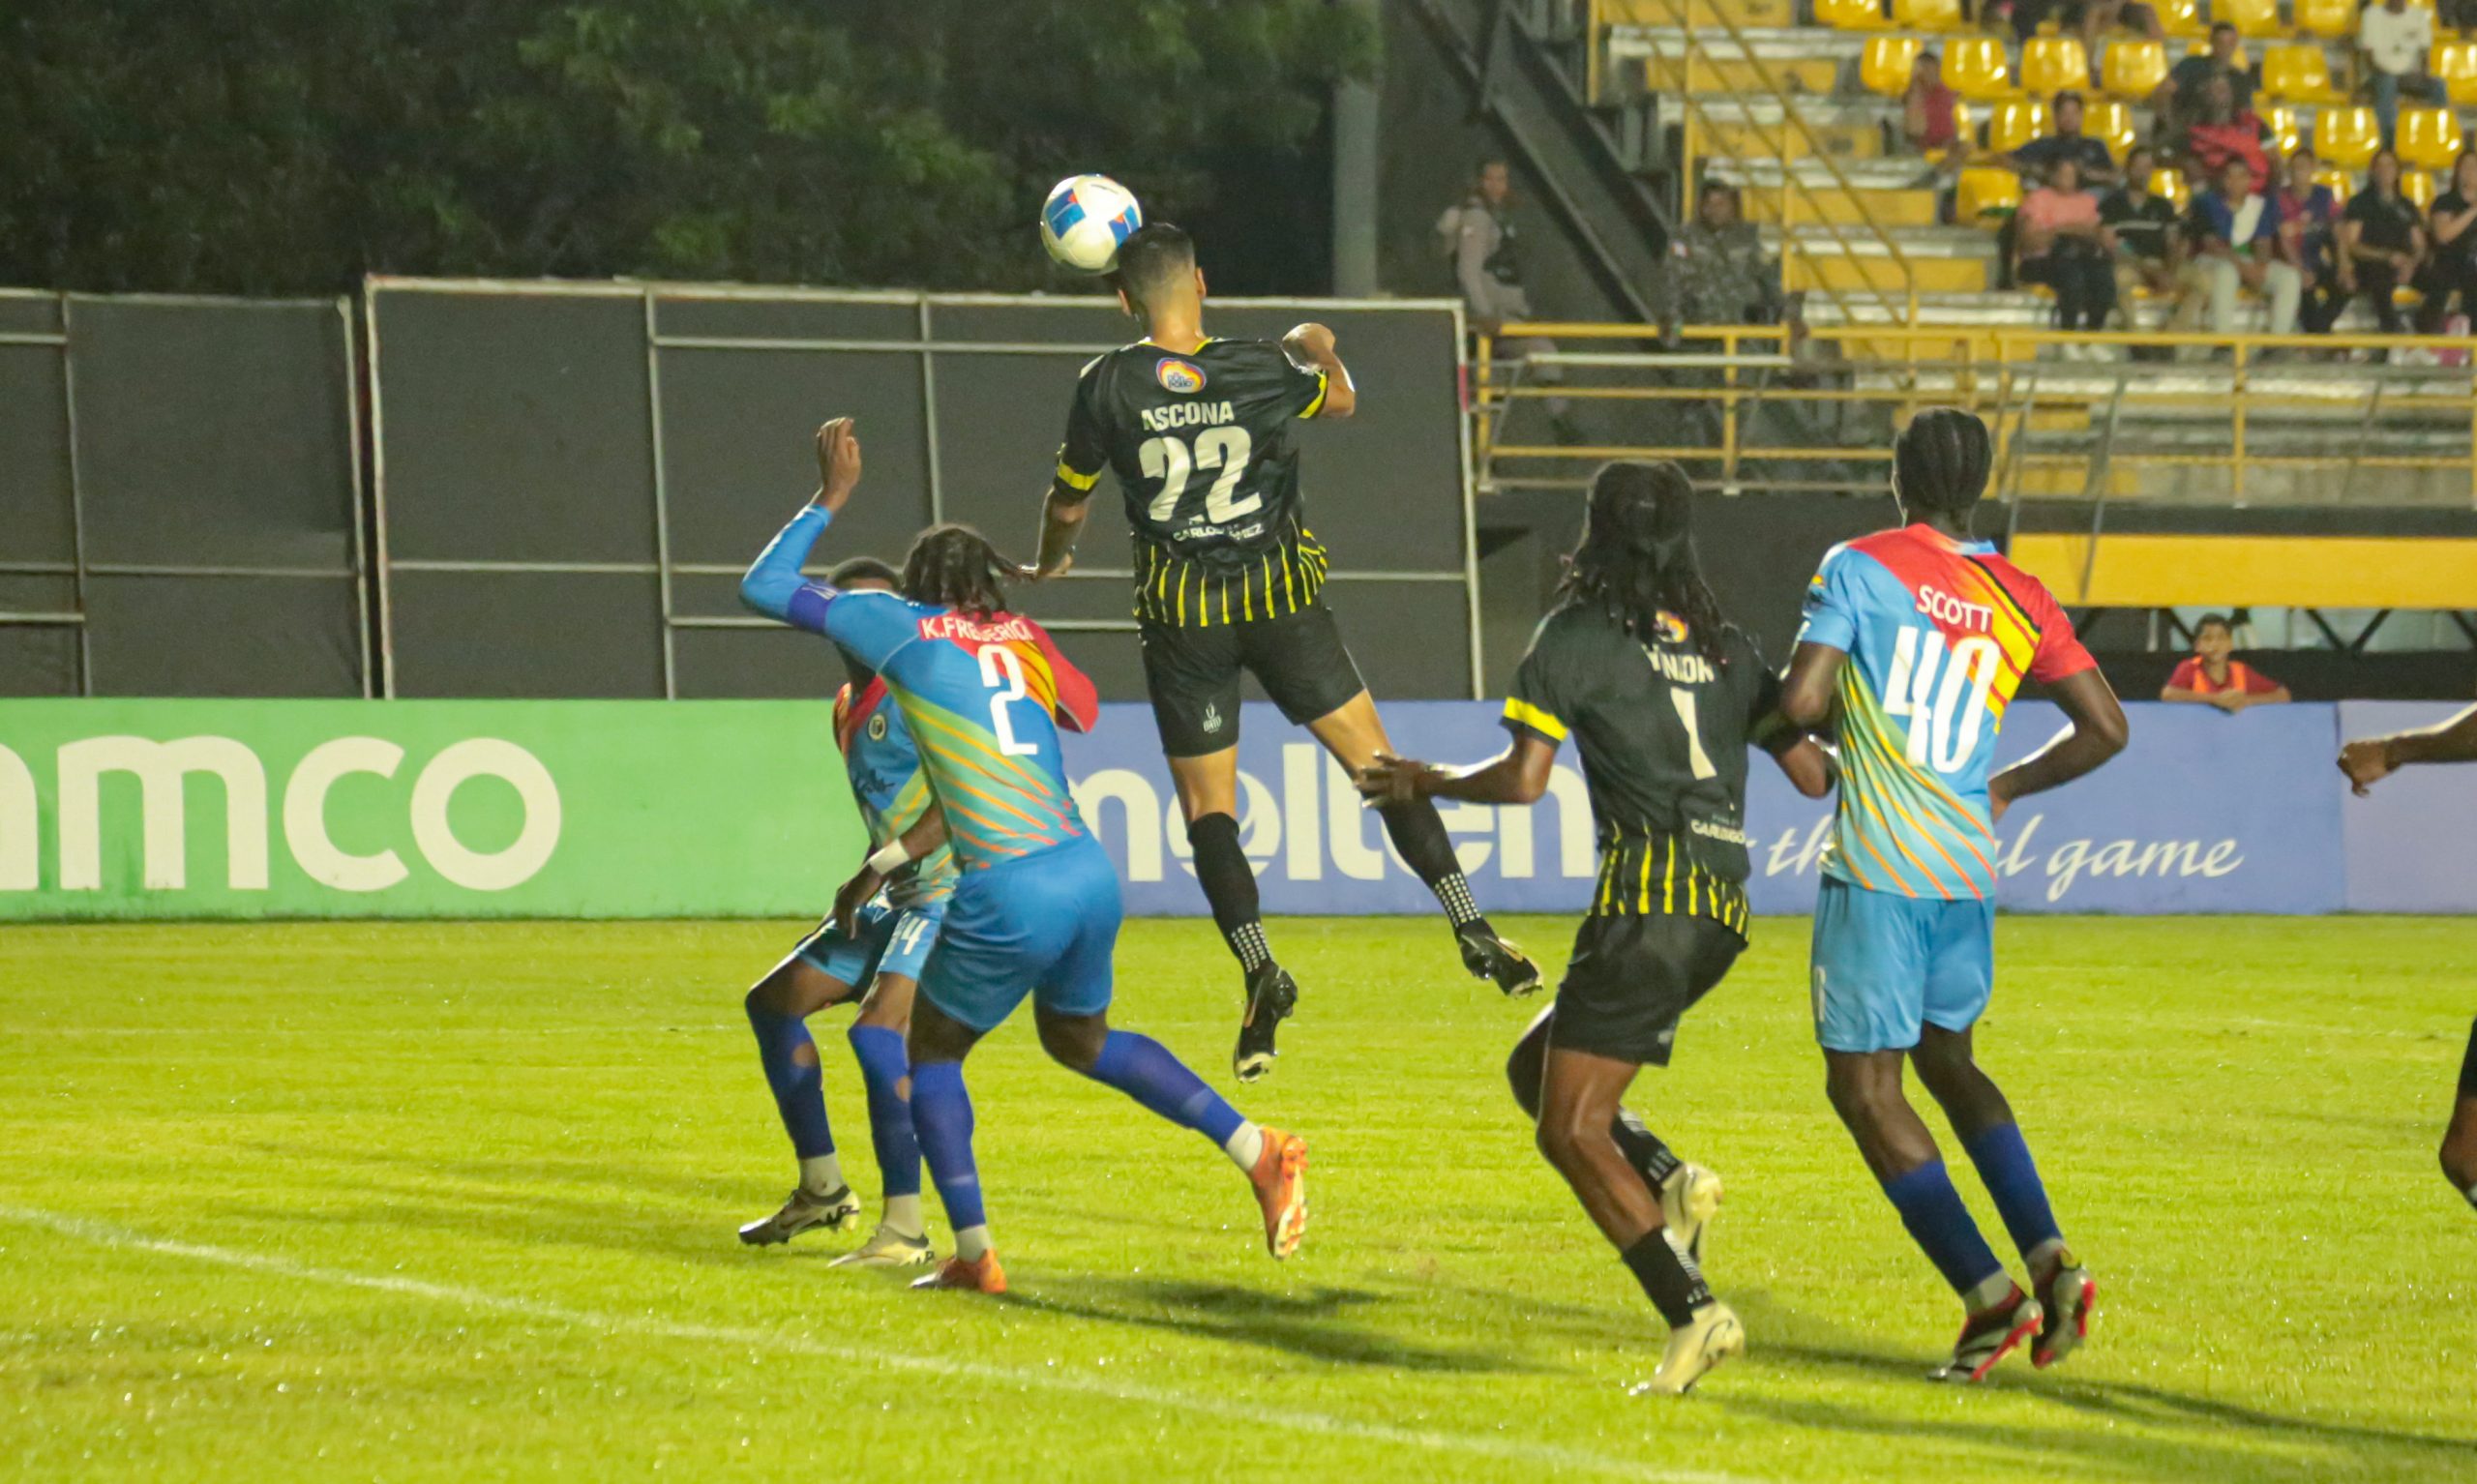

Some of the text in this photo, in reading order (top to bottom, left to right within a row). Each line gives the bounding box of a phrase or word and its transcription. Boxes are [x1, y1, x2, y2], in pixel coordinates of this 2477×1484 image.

[1141, 401, 1235, 431] ASCONA
[1139, 426, 1263, 524] 22
[1916, 584, 1993, 633] SCOTT
[977, 644, 1038, 757] 2
[1883, 625, 2002, 774] 40
[2047, 839, 2245, 902] game
